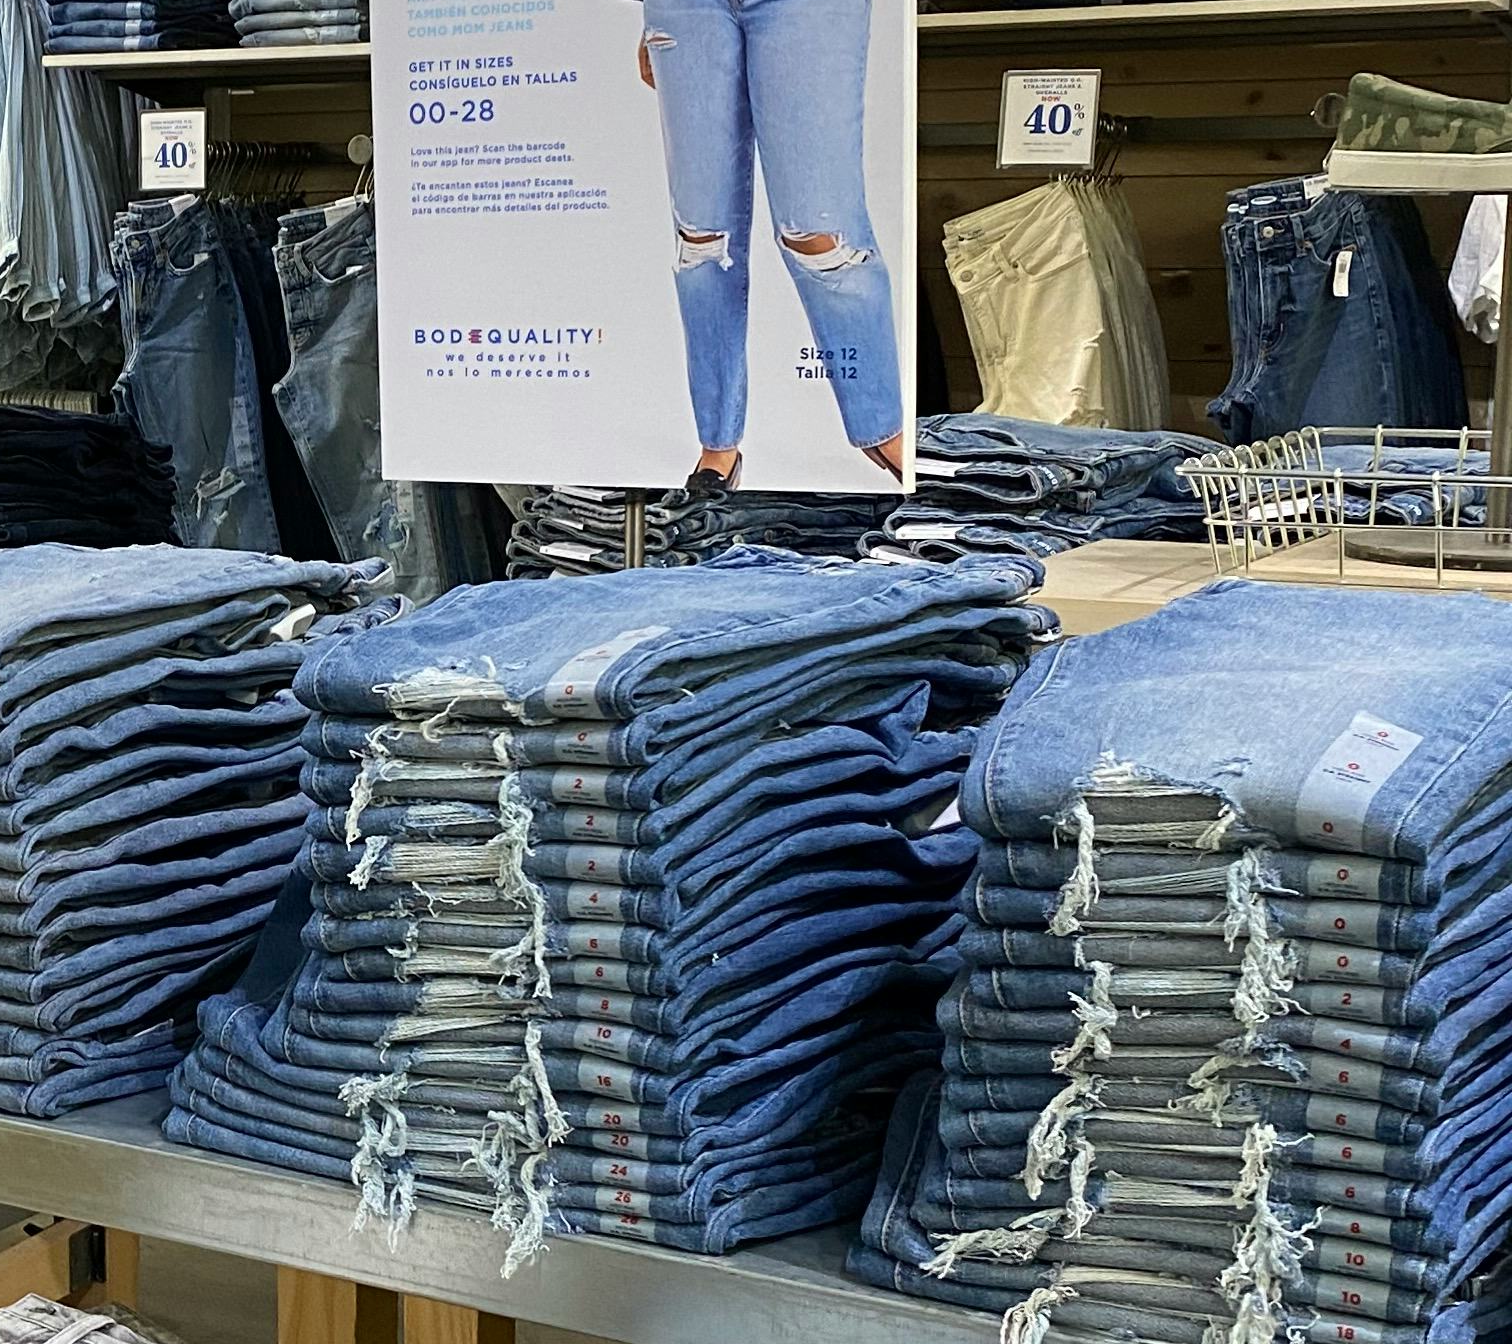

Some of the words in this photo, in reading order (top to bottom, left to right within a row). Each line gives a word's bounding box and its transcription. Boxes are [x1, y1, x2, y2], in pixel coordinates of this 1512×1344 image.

[408, 6, 466, 21] TAMBIÉN
[471, 0, 555, 16] CONOCIDOS
[408, 25, 448, 38] COMO
[452, 23, 485, 35] MOM
[488, 20, 533, 33] JEANS
[409, 61, 434, 72] GET
[439, 60, 450, 71] IT
[456, 59, 470, 70] IN
[475, 57, 513, 69] SIZES
[410, 74, 496, 90] CONSÍGUELO
[502, 75, 519, 85] EN
[525, 72, 577, 85] TALLAS
[409, 99, 494, 124] 00-28
[1024, 104, 1072, 134] 40
[154, 142, 187, 168] 40
[411, 147, 432, 156] Love
[435, 146, 452, 155] this
[455, 145, 479, 155] jean?
[483, 144, 505, 153] Scan
[508, 144, 523, 152] the
[526, 142, 565, 151] barcode
[440, 159, 458, 167] app
[461, 158, 474, 166] for
[505, 155, 542, 165] product
[429, 181, 471, 190] encantan
[474, 181, 498, 189] estos
[502, 179, 531, 189] jeans?
[534, 178, 573, 186] Escanea
[412, 208, 432, 216] para
[435, 206, 480, 214] encontrar
[483, 204, 501, 212] más
[505, 203, 541, 212] detalles
[446, 354, 464, 362] we
[477, 352, 546, 362] deserve
[558, 353, 570, 362] it
[800, 347, 834, 360] Size
[841, 348, 857, 360] 12
[427, 369, 453, 377] nos
[465, 368, 479, 377] lo
[491, 369, 590, 377] merecemos
[796, 366, 833, 379] Talla
[841, 367, 857, 379] 12
[597, 1028, 611, 1038] 10
[604, 1114, 620, 1124] 20
[610, 1164, 627, 1176] 24
[1346, 1252, 1364, 1266] 10
[1337, 1326, 1354, 1340] 18
